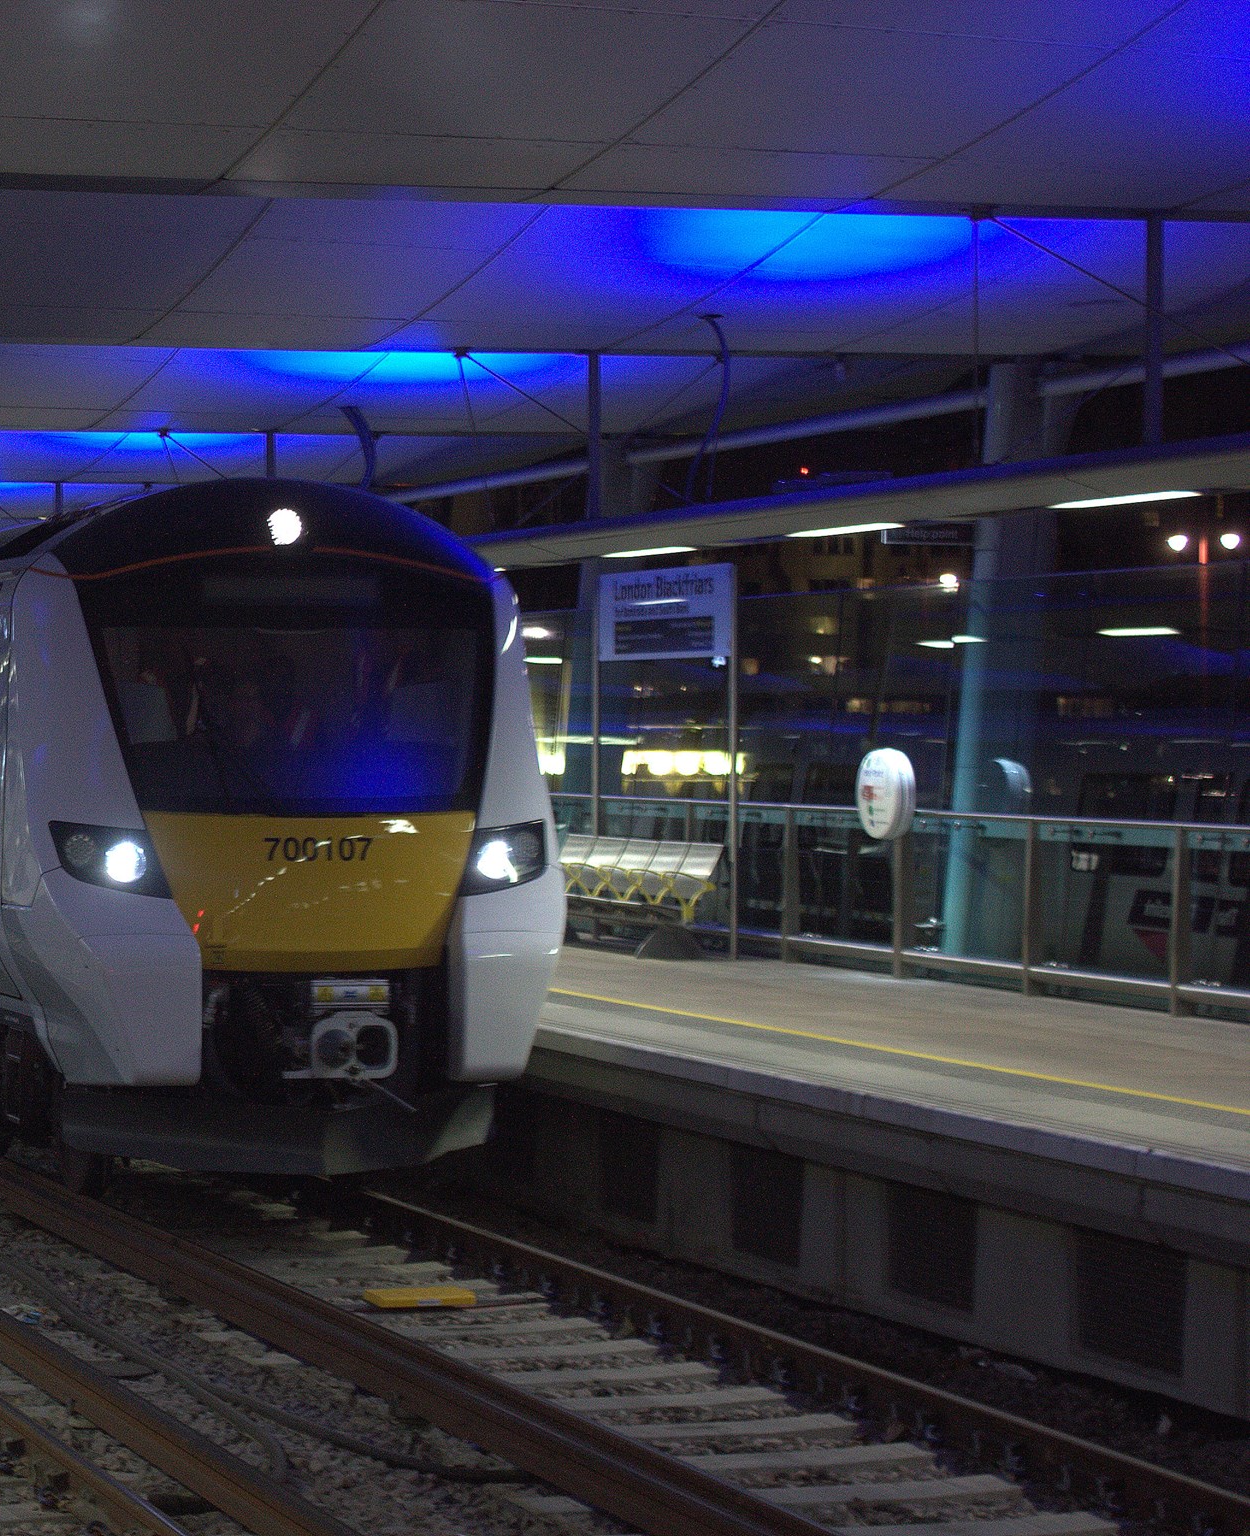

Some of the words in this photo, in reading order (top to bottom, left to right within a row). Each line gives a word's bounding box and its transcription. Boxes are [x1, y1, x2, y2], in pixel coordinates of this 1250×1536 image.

[614, 577, 652, 601] London
[654, 574, 713, 598] Blackfriars
[264, 836, 373, 862] 700107
